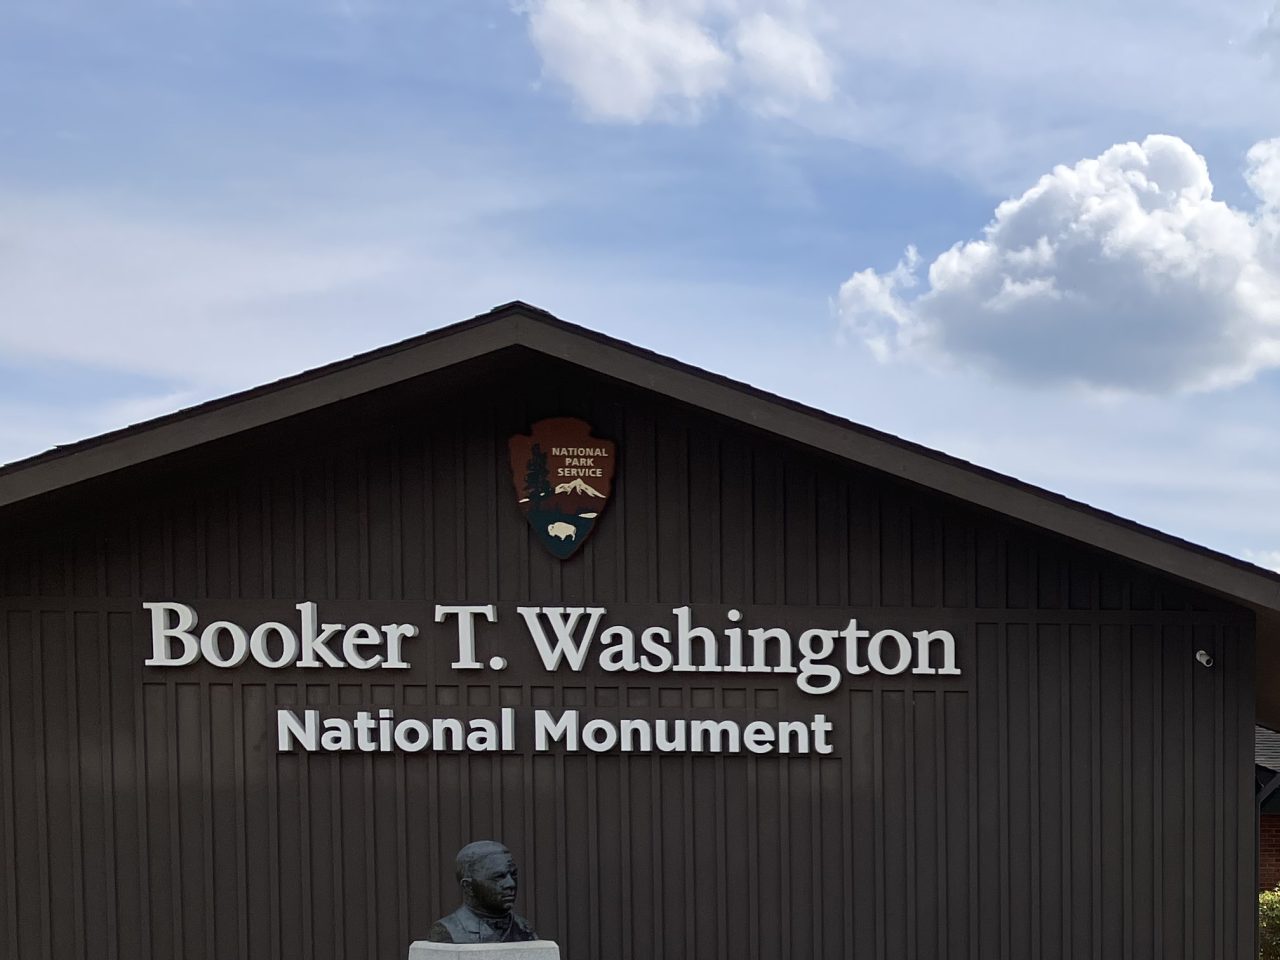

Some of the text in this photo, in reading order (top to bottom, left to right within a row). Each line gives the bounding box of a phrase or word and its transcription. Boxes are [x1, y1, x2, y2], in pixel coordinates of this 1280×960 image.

[552, 447, 608, 456] NATIONAL
[565, 458, 594, 466] PARK
[557, 468, 603, 477] SERVICE
[143, 601, 961, 695] Booker T. Washington
[277, 707, 834, 754] National Monument
